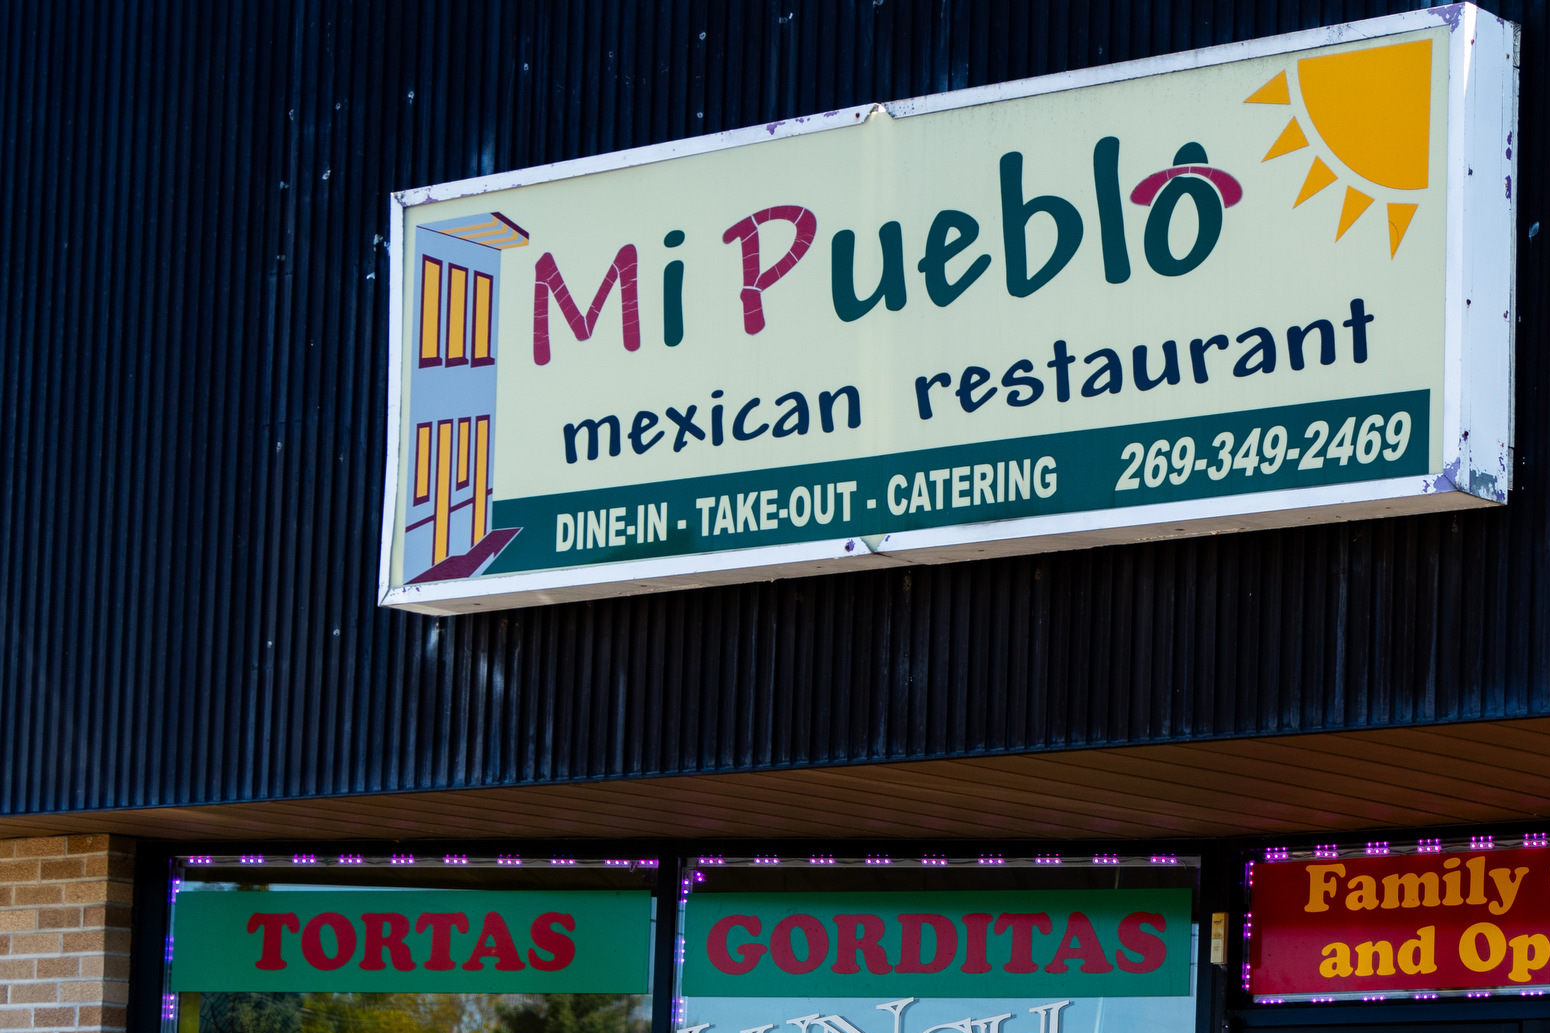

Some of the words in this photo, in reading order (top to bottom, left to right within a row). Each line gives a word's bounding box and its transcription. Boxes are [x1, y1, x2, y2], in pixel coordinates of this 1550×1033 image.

[533, 229, 686, 366] Mi
[722, 135, 1236, 336] Pueblo
[563, 385, 862, 464] mexican
[914, 298, 1374, 420] restaurant
[555, 502, 668, 553] DINE-IN
[696, 481, 858, 536] TAKE-OUT
[887, 456, 1058, 517] CATERING
[1115, 411, 1412, 492] 269-349-2469
[1304, 857, 1529, 915] Family
[246, 911, 576, 972] TORTAS
[706, 911, 1168, 976] GORDITAS
[1319, 926, 1437, 978] and
